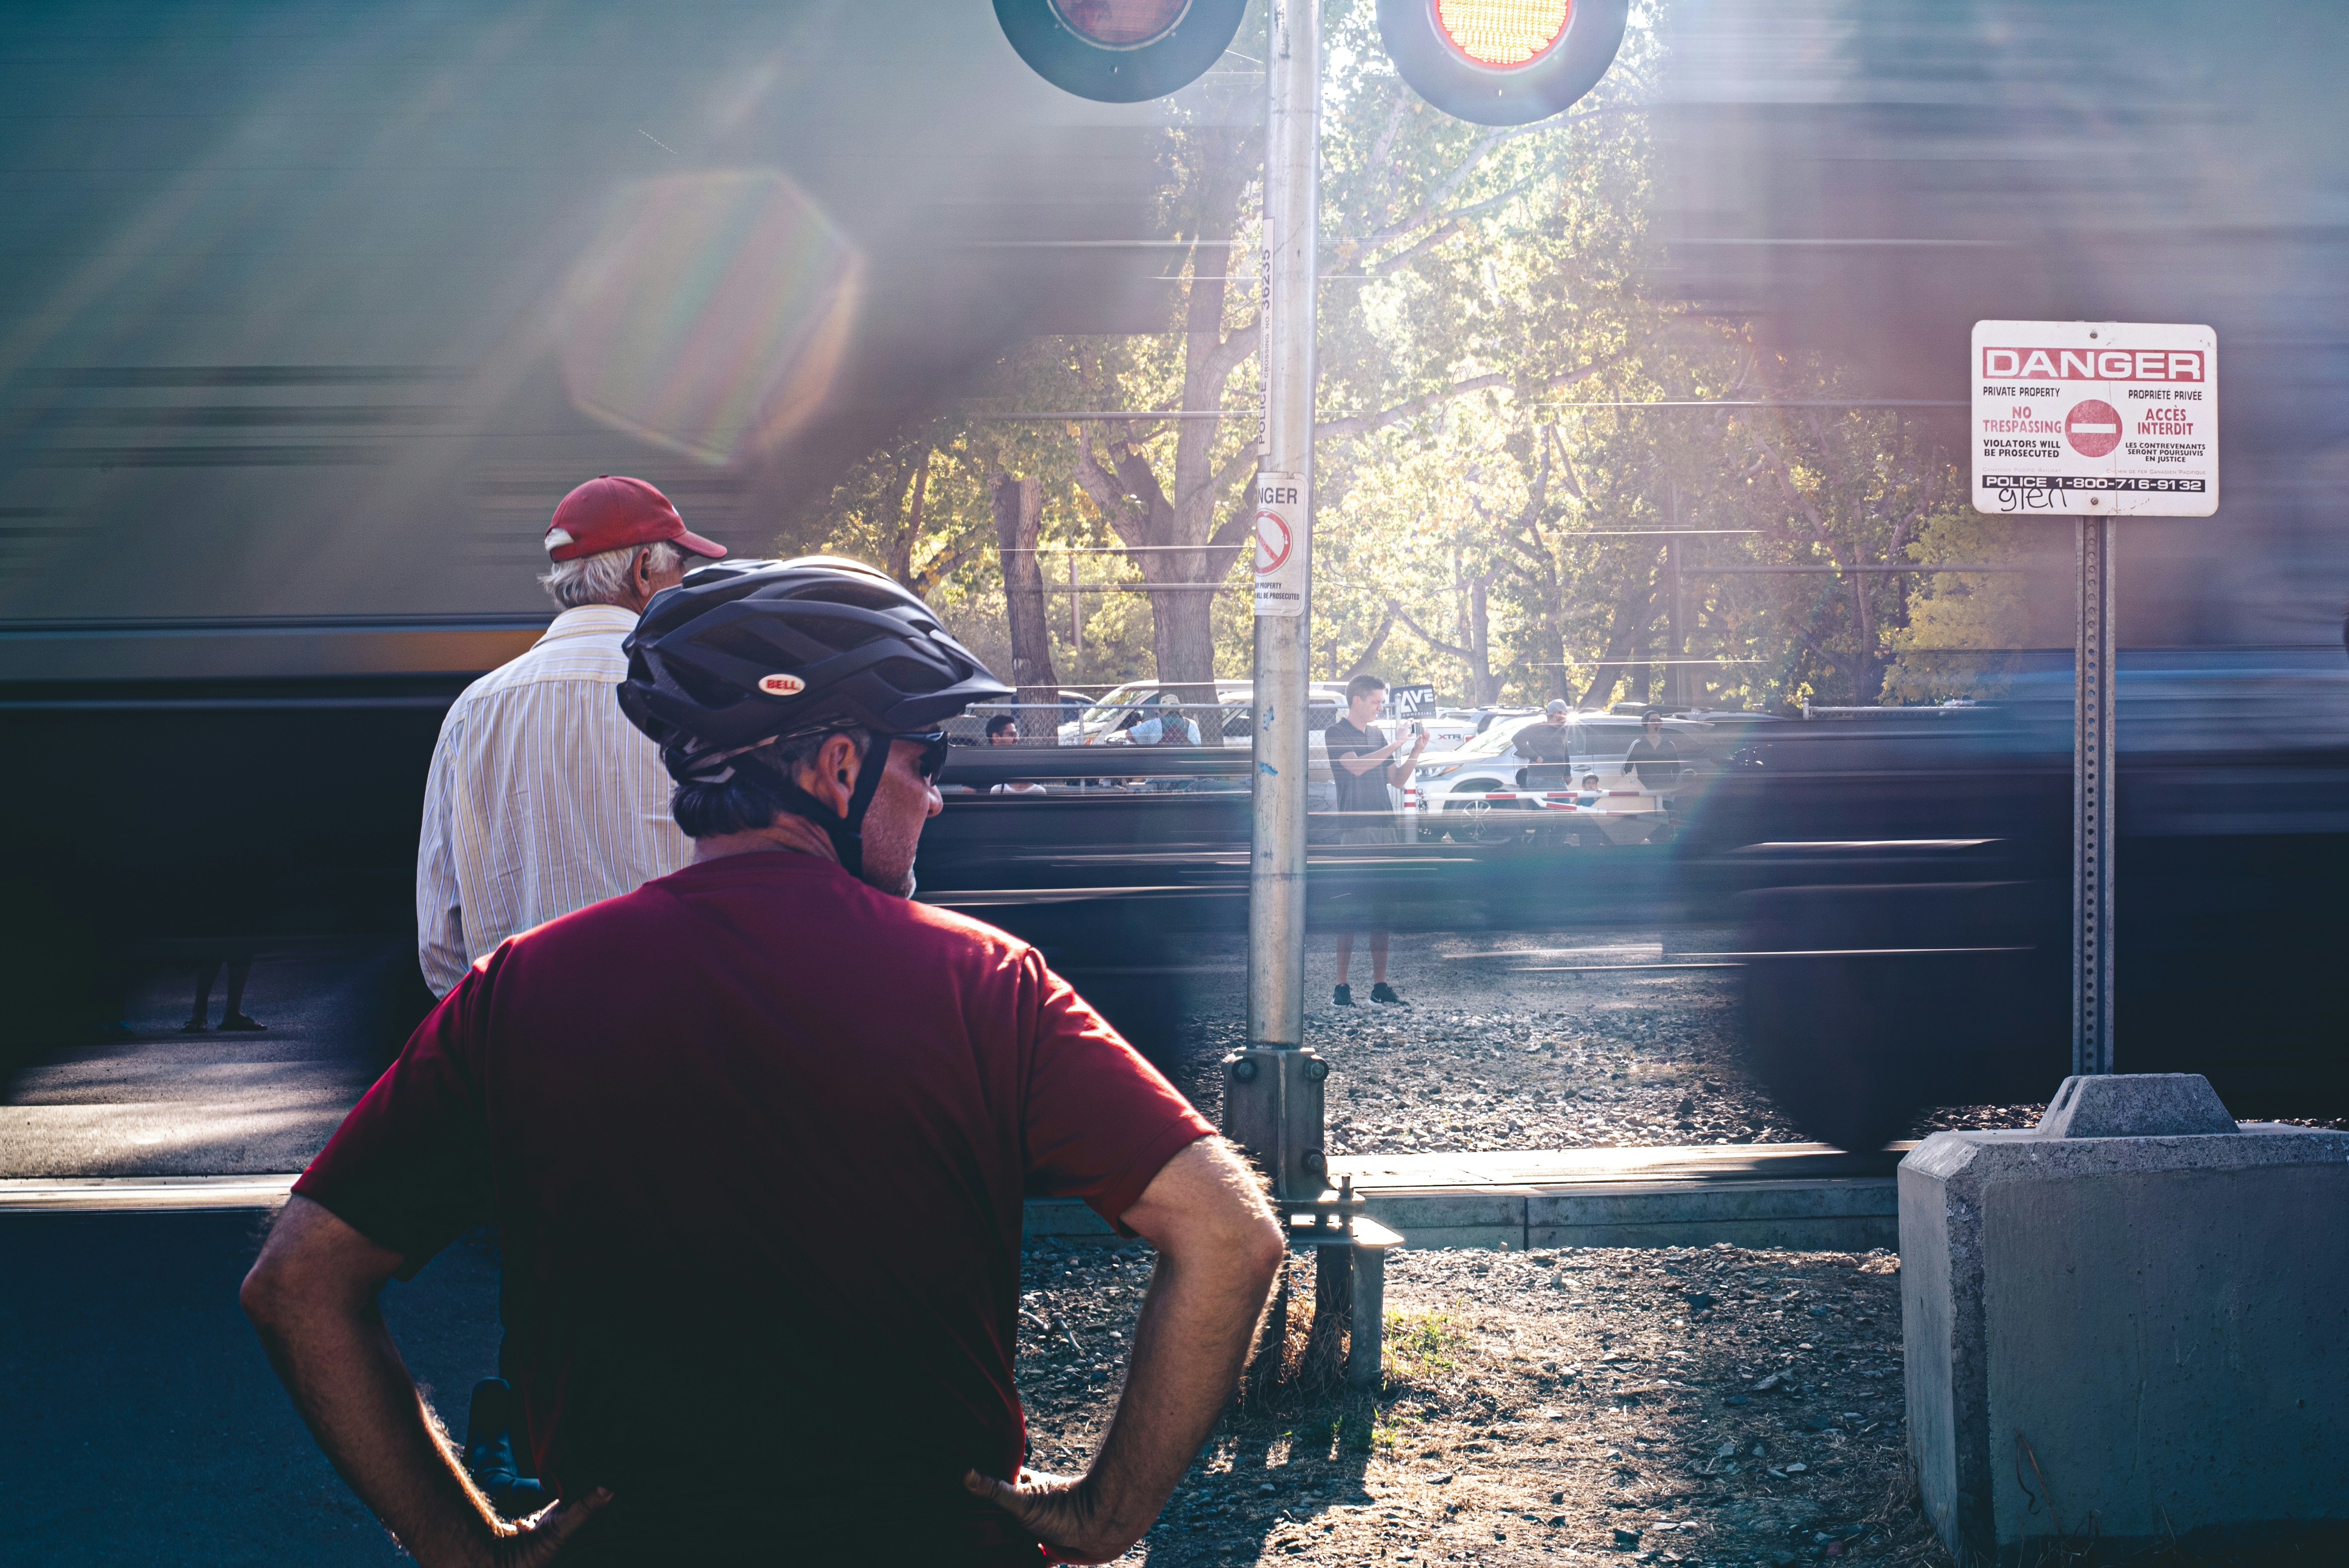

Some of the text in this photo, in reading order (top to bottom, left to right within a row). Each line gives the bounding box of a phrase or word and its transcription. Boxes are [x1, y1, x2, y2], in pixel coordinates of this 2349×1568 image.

[1262, 249, 1270, 311] 36235
[1986, 350, 2200, 380] DANGER
[1983, 386, 2060, 397] PRIVATE PROPERTY
[2128, 388, 2202, 400] PROPRIÉTÉ PRIVÉE
[2012, 406, 2031, 419] NO
[2145, 405, 2186, 421] ACCÈS
[1983, 419, 2061, 434] TRESPASSING
[2138, 422, 2193, 435] INTERDIT
[1983, 439, 2060, 448] VIOLATORS WILL
[1999, 449, 2059, 457] PROSECUTED
[1986, 476, 2201, 490] POLICE 1-800-716-9132
[1258, 487, 1298, 504] NGER
[1999, 487, 2067, 512] glen
[767, 679, 798, 690] BELL
